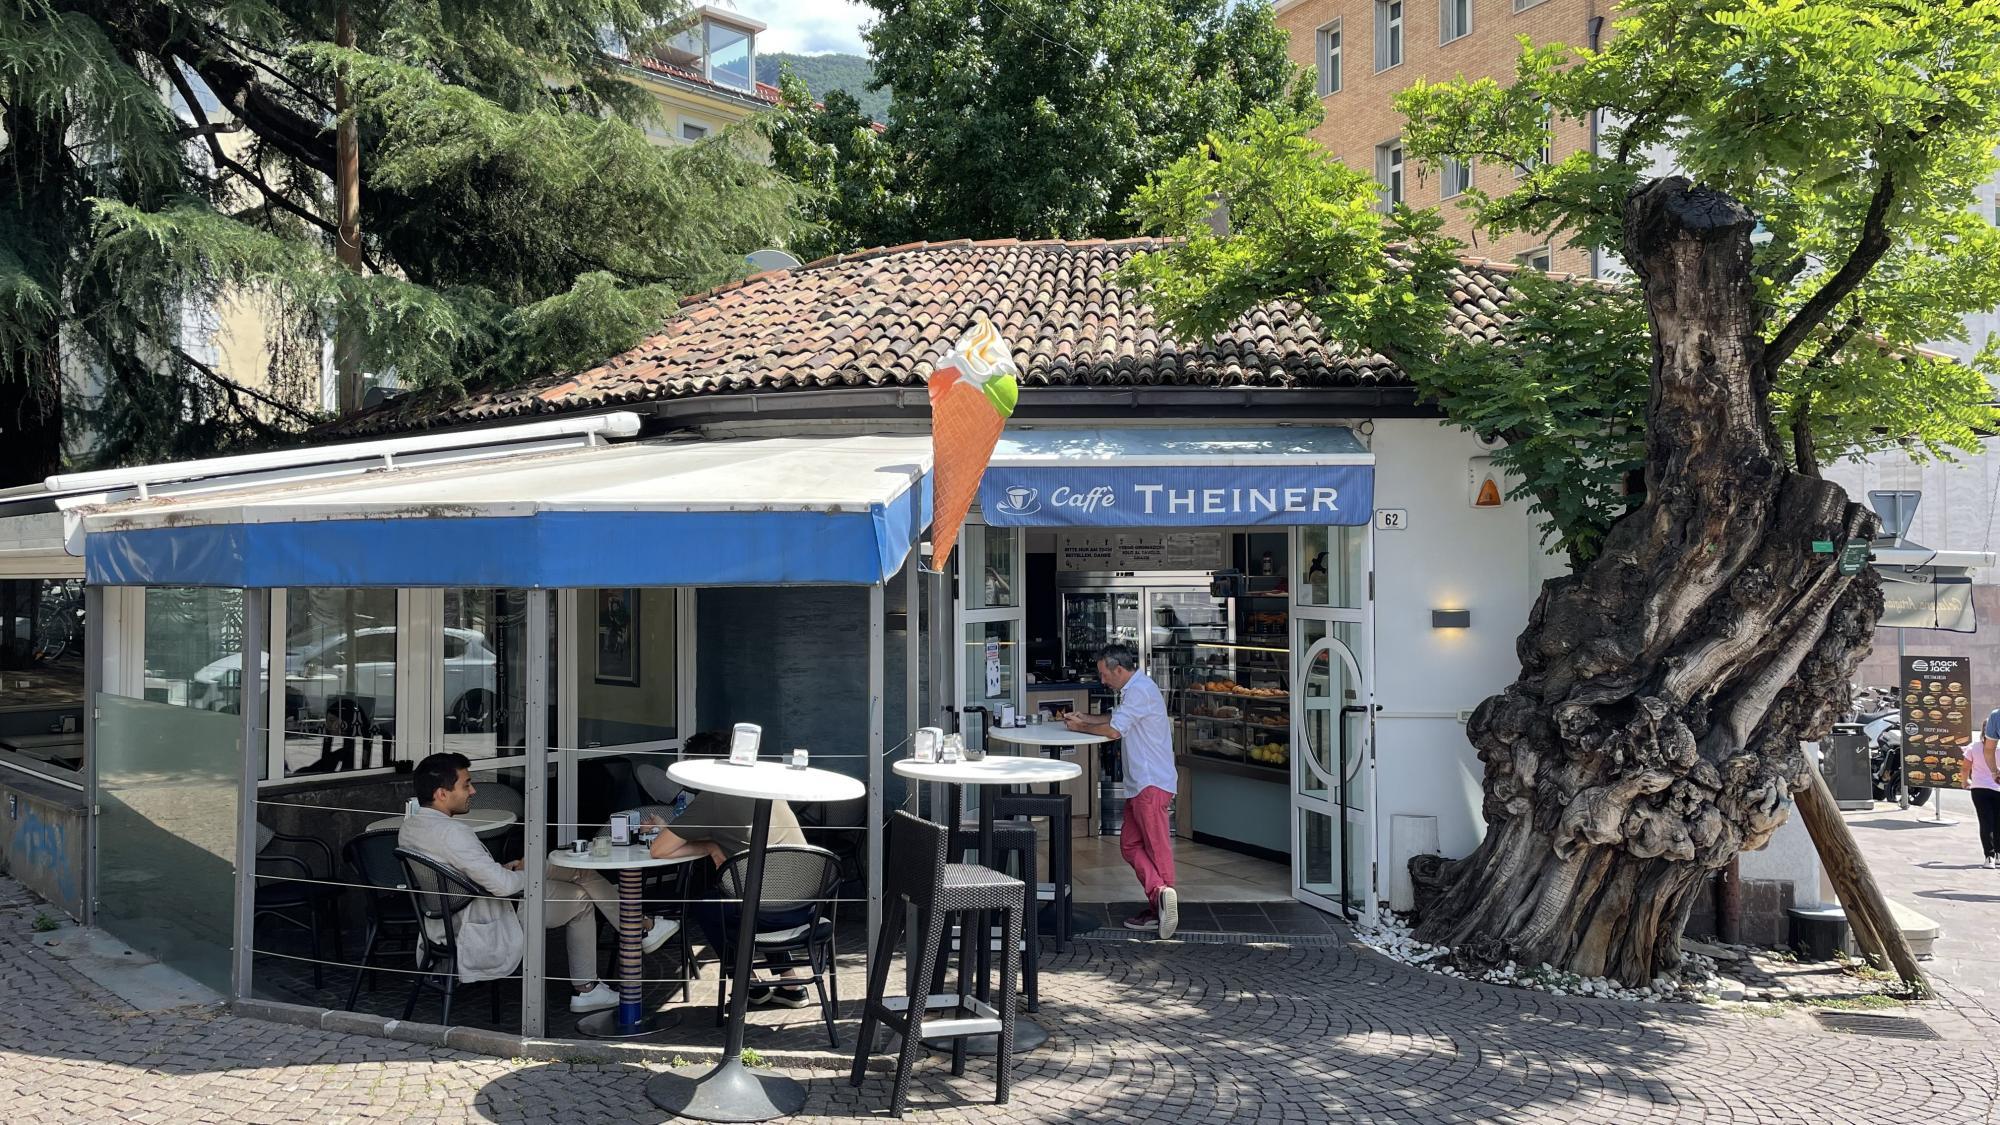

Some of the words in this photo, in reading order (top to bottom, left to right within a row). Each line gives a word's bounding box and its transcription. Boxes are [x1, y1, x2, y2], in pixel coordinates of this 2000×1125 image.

[1050, 486, 1116, 514] Caffè
[1134, 484, 1339, 514] THEINER
[1385, 513, 1398, 526] 62
